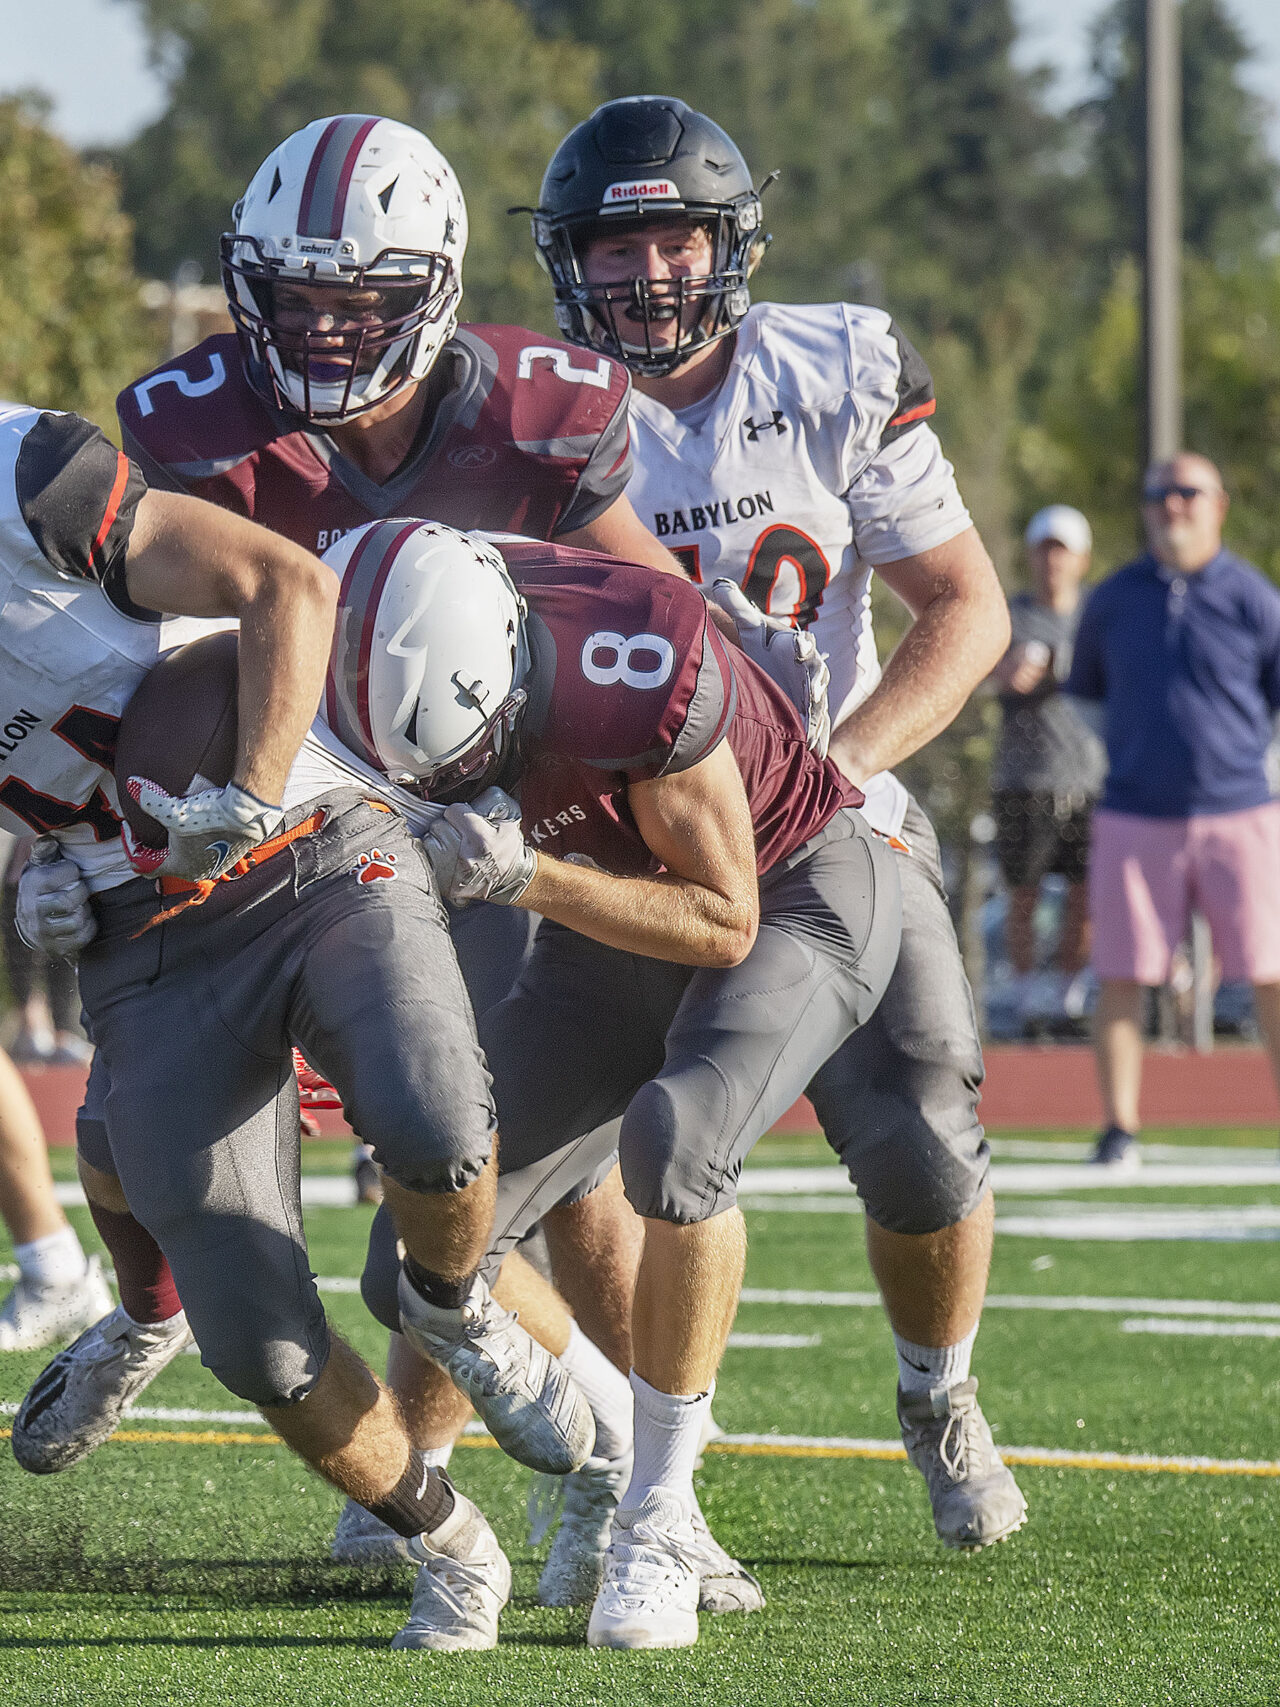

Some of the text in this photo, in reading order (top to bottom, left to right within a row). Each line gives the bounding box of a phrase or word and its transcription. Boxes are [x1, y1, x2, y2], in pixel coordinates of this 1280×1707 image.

[611, 184, 669, 198] Riddell
[300, 244, 333, 255] schutt
[133, 352, 227, 417] 2
[517, 346, 613, 390] 2
[653, 490, 776, 536] BABYLON
[667, 523, 831, 632] 0
[580, 630, 676, 691] 8
[524, 804, 587, 845] KERS
